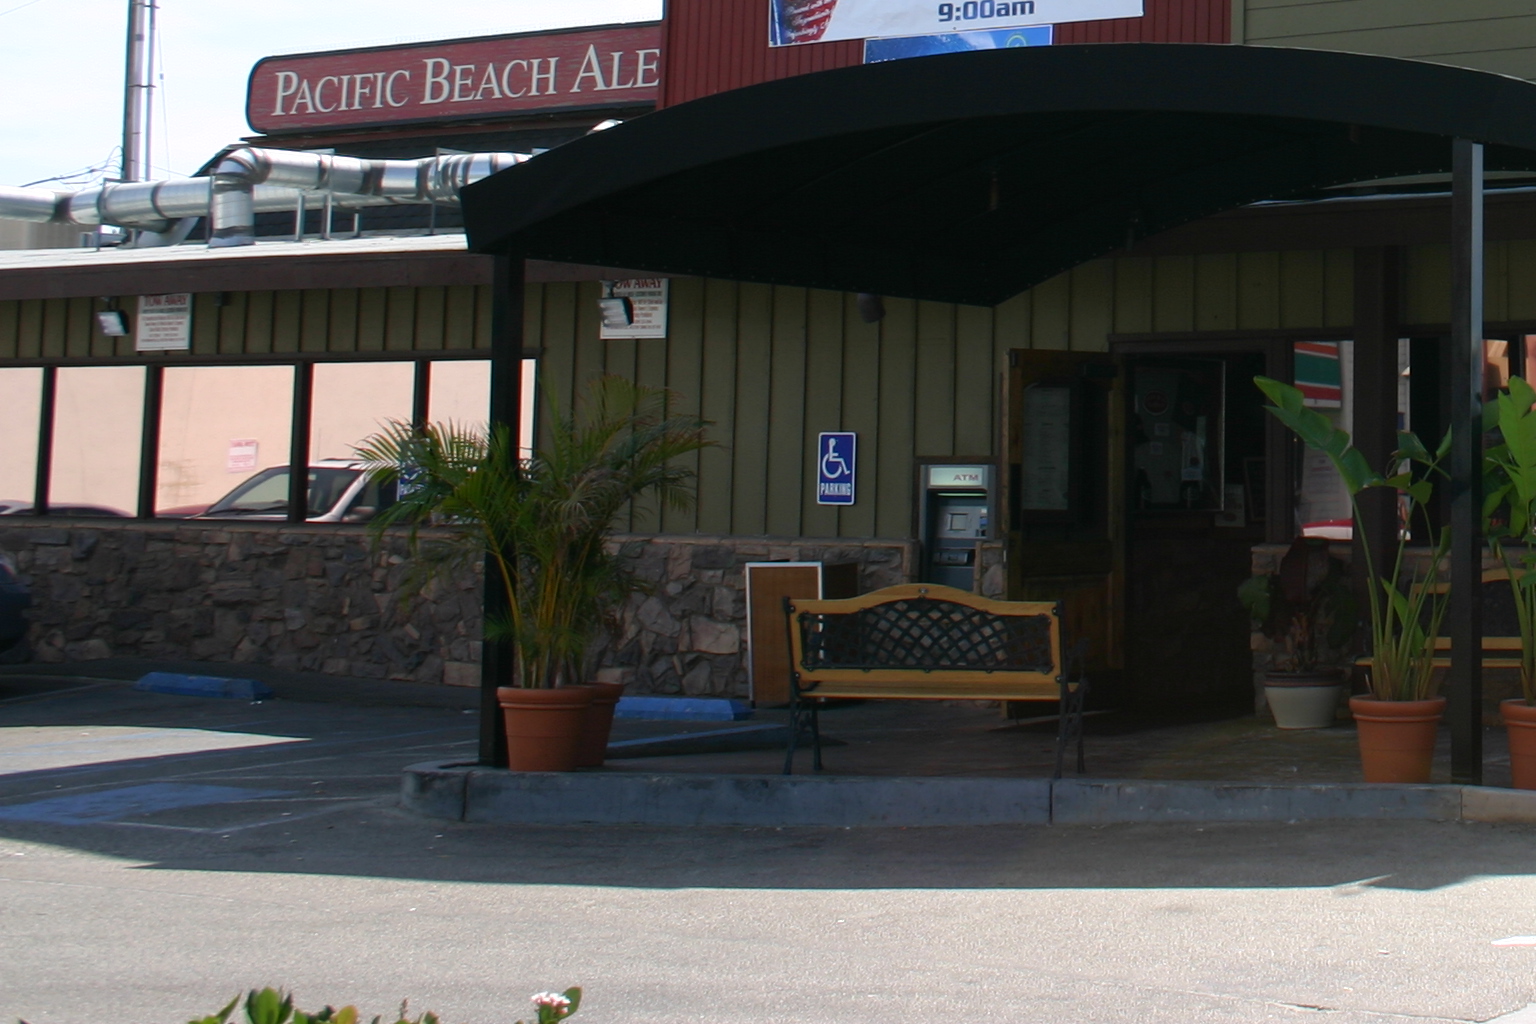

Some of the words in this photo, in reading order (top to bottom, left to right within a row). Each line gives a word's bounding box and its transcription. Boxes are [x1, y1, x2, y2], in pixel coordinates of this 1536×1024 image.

[938, 0, 1035, 23] 9:00am
[270, 70, 410, 117] PACIFIC
[419, 57, 561, 105] BEACH
[953, 474, 979, 482] ATM
[820, 482, 851, 496] PARKING
